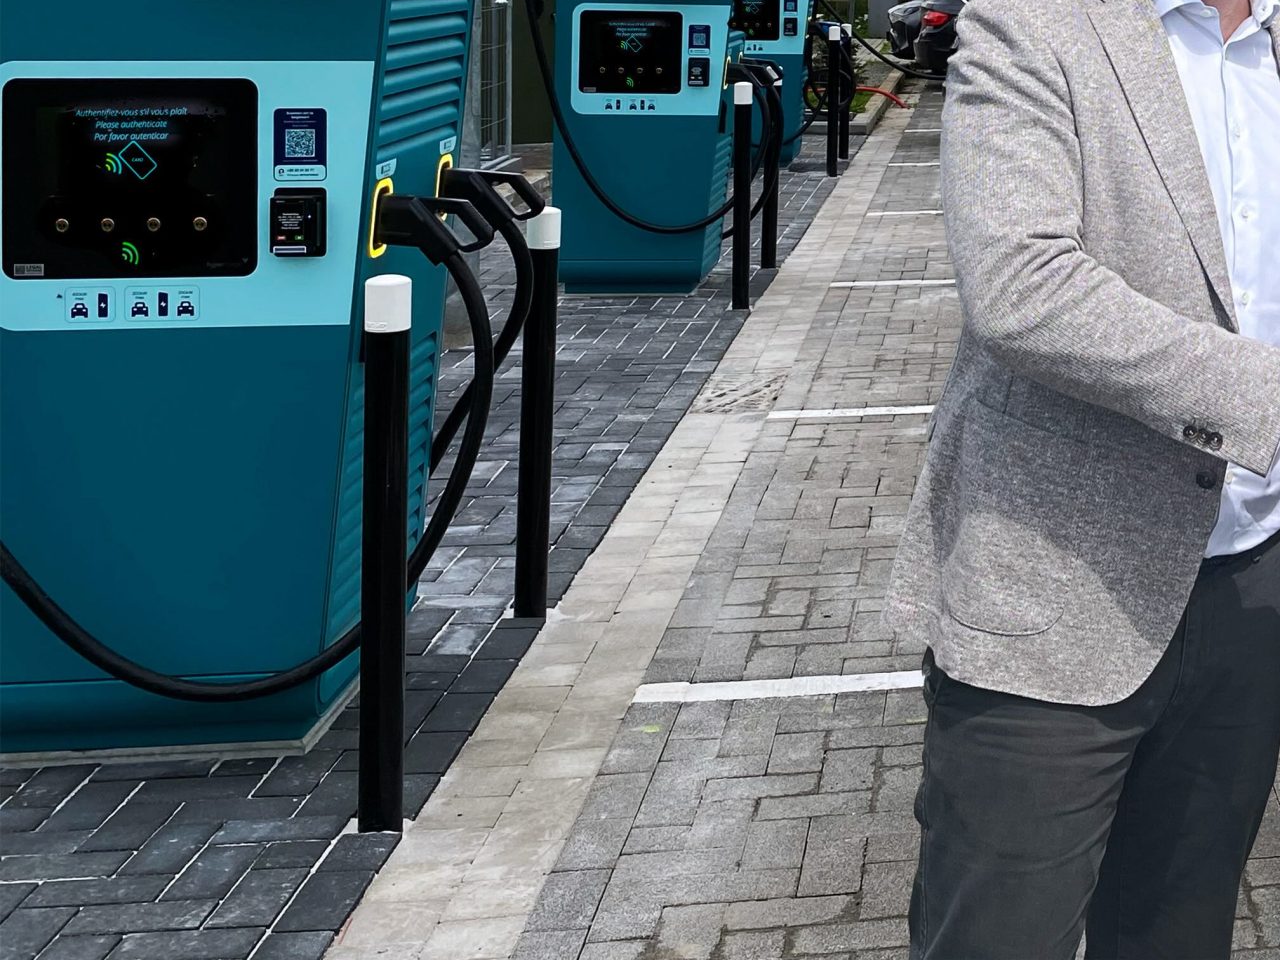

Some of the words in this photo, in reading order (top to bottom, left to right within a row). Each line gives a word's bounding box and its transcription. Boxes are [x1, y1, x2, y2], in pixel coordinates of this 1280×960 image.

[150, 108, 168, 116] vous
[95, 120, 119, 129] Please
[121, 120, 168, 128] authenticate
[94, 133, 107, 141] Por
[107, 132, 129, 143] favor
[130, 132, 169, 141] autenticar
